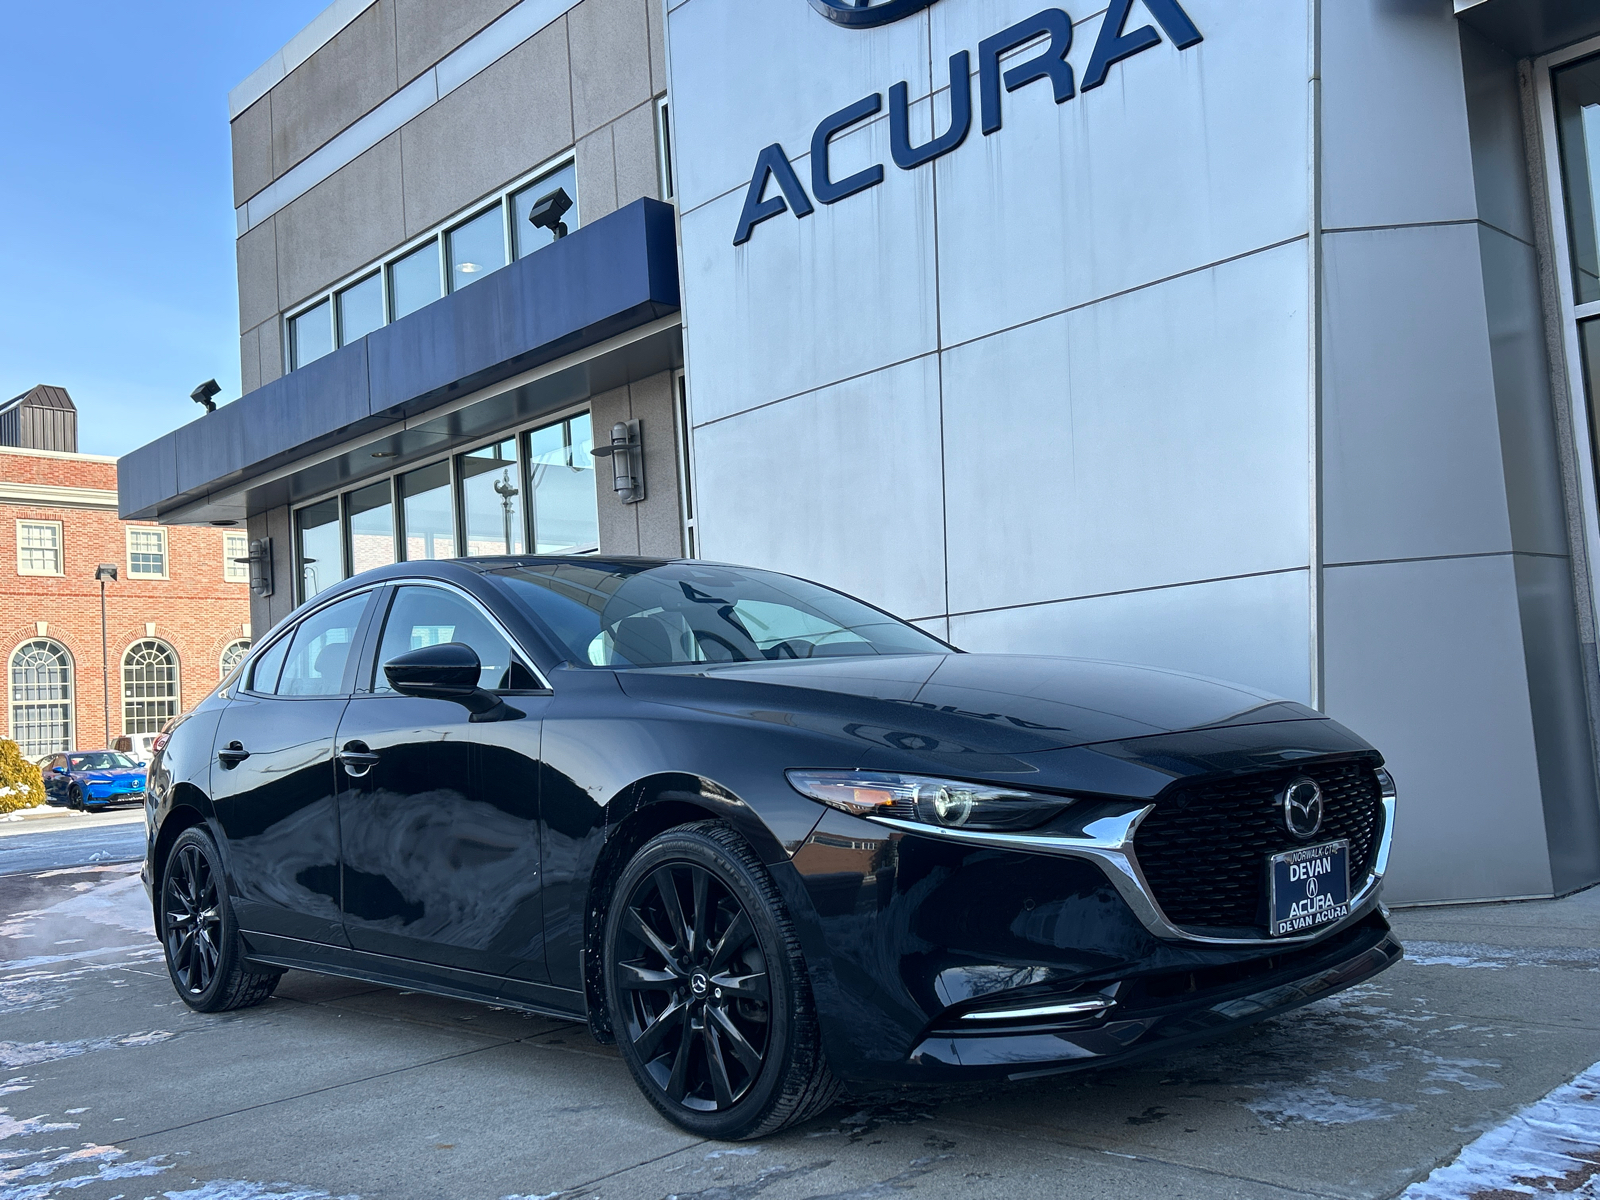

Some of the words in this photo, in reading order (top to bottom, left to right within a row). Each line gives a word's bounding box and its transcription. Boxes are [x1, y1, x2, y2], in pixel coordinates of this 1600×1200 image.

[732, 0, 1204, 246] ACURA
[1290, 856, 1331, 882] DEVAN
[1289, 893, 1334, 918] ACURA
[1279, 915, 1313, 935] DEVAN
[1315, 905, 1348, 923] ACURA
